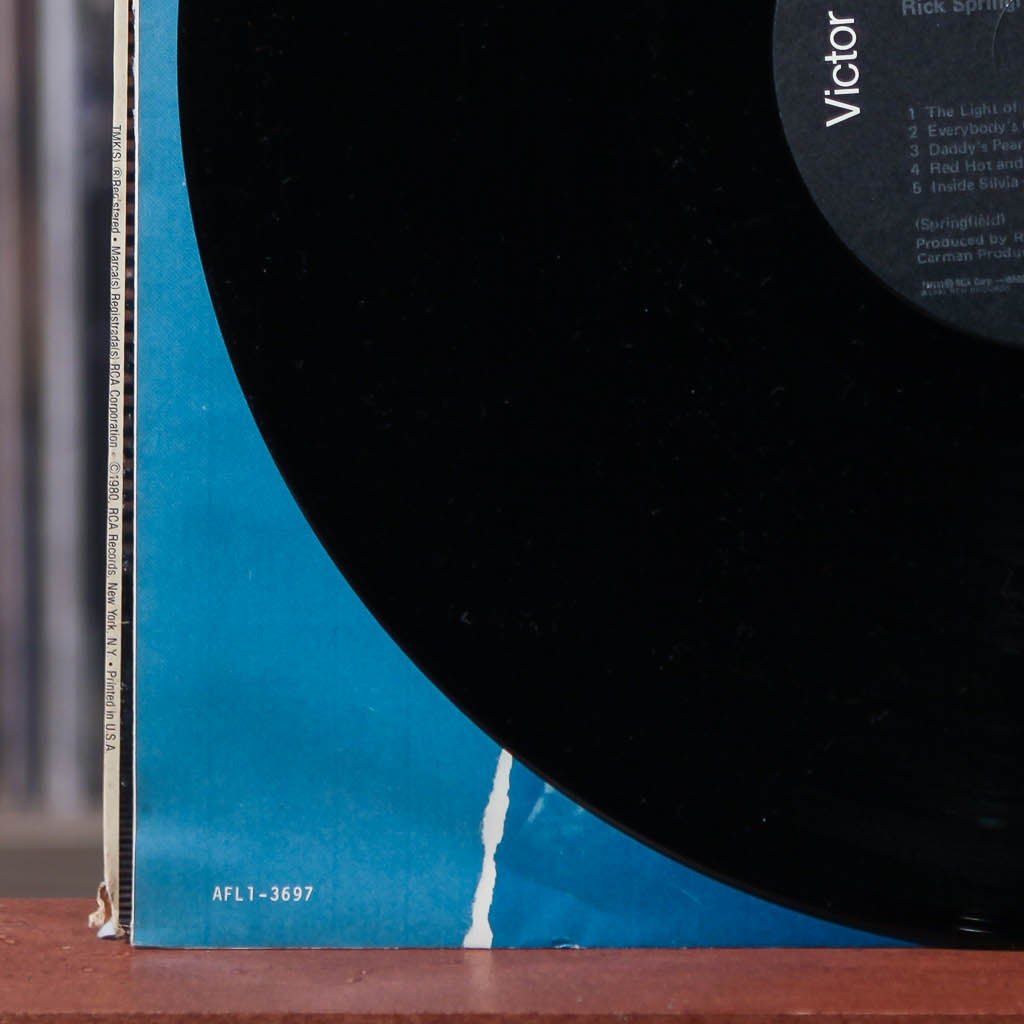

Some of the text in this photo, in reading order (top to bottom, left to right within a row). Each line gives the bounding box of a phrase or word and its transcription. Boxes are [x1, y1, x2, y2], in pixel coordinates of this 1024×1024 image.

[823, 9, 862, 129] Victor
[908, 107, 915, 121] 1
[927, 104, 954, 118] The
[960, 102, 999, 119] Light
[1003, 101, 1017, 114] of
[909, 124, 918, 139] 2
[910, 143, 920, 158] 3
[910, 162, 920, 176] 4
[929, 160, 961, 175] Red
[964, 158, 993, 173] Hot
[995, 156, 1024, 171] and
[930, 178, 976, 194] Inside
[915, 234, 985, 250] Produced
[988, 232, 1008, 247] by
[916, 250, 974, 266] Carman
[110, 362, 121, 386] RCA
[110, 389, 121, 448] Corporation
[108, 507, 119, 530] RCA
[107, 581, 118, 606] New
[106, 669, 118, 708] Printed
[106, 709, 117, 720] in
[211, 885, 315, 902] AFL1-3697
